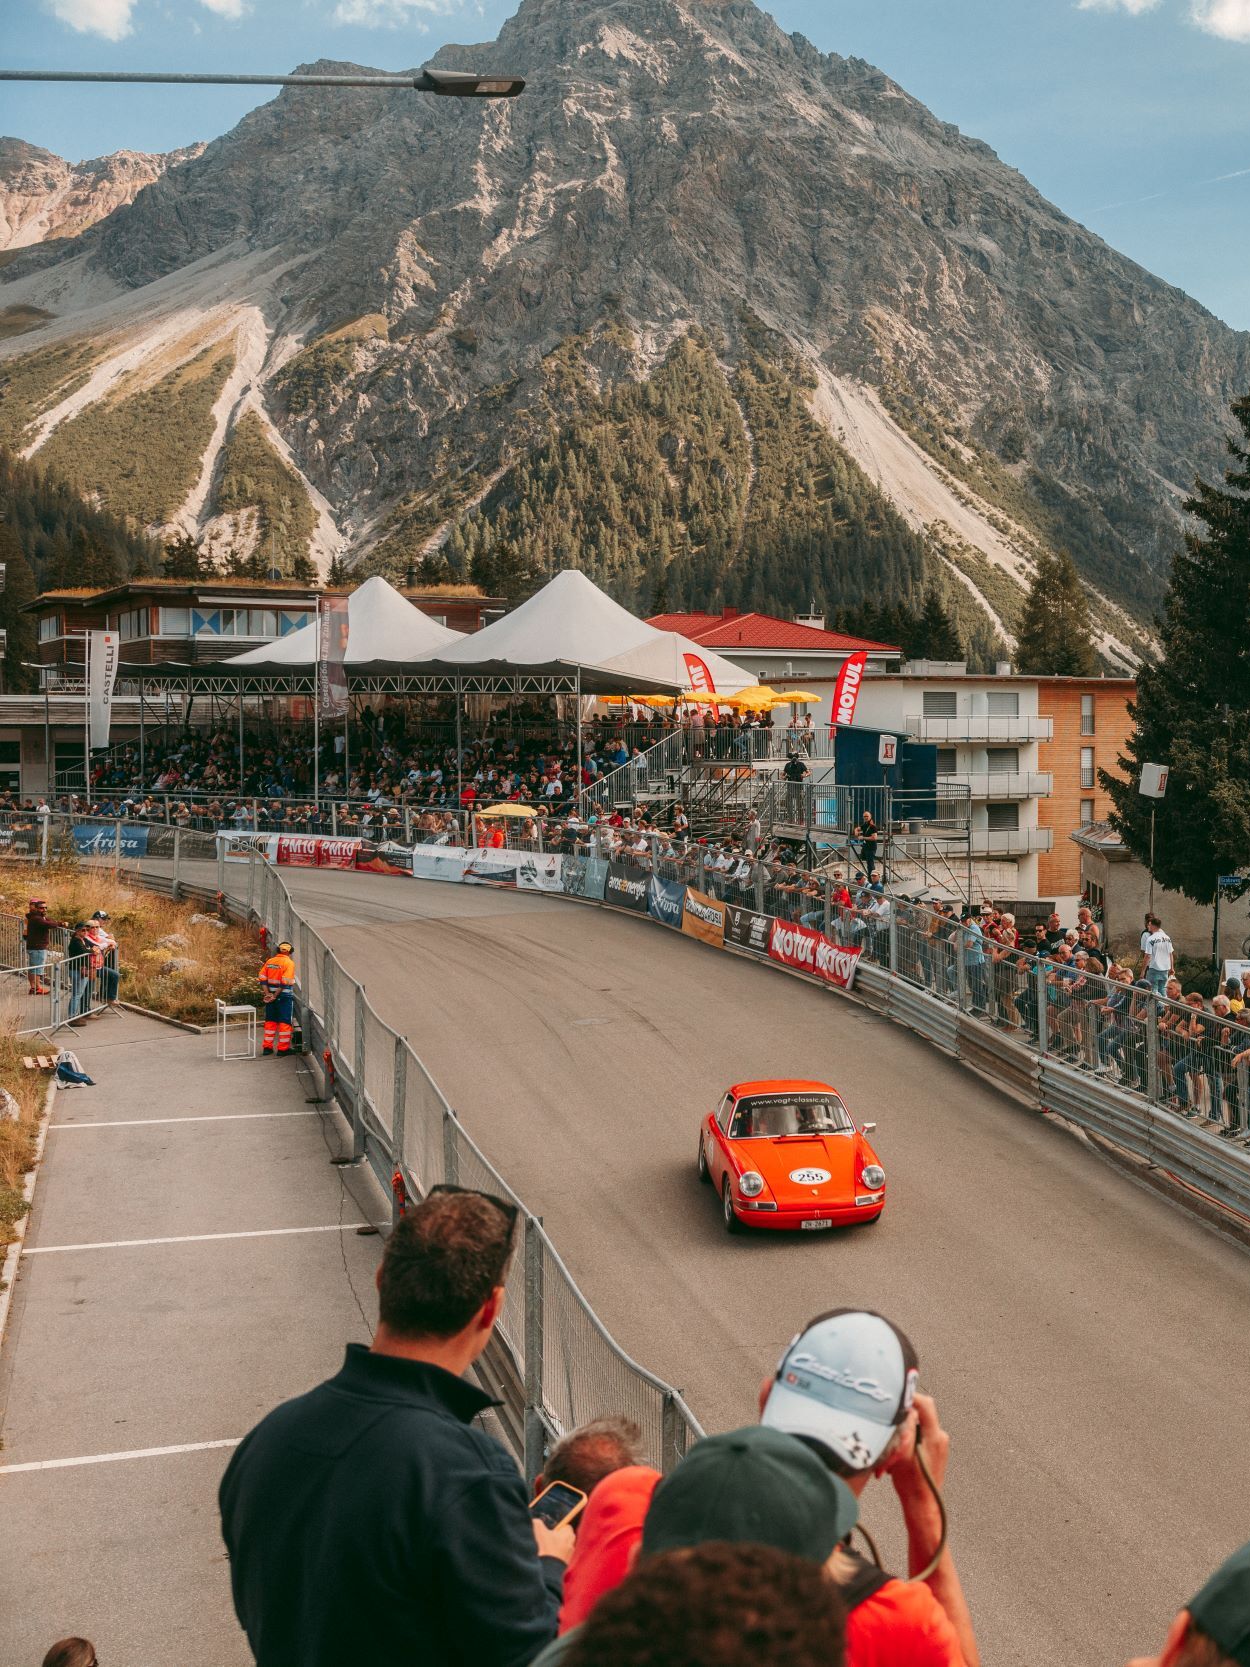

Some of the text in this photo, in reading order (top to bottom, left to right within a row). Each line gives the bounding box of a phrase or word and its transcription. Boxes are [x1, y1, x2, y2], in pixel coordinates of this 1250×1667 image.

[103, 645, 115, 705] CASTELLI
[836, 662, 863, 725] MOTUL
[80, 832, 139, 849] Arosa
[281, 838, 316, 854] PM10
[321, 840, 355, 856] PM10
[771, 926, 816, 962] MOTUL
[751, 1096, 830, 1106] www.vogt-classic.ch
[798, 1173, 824, 1182] 255
